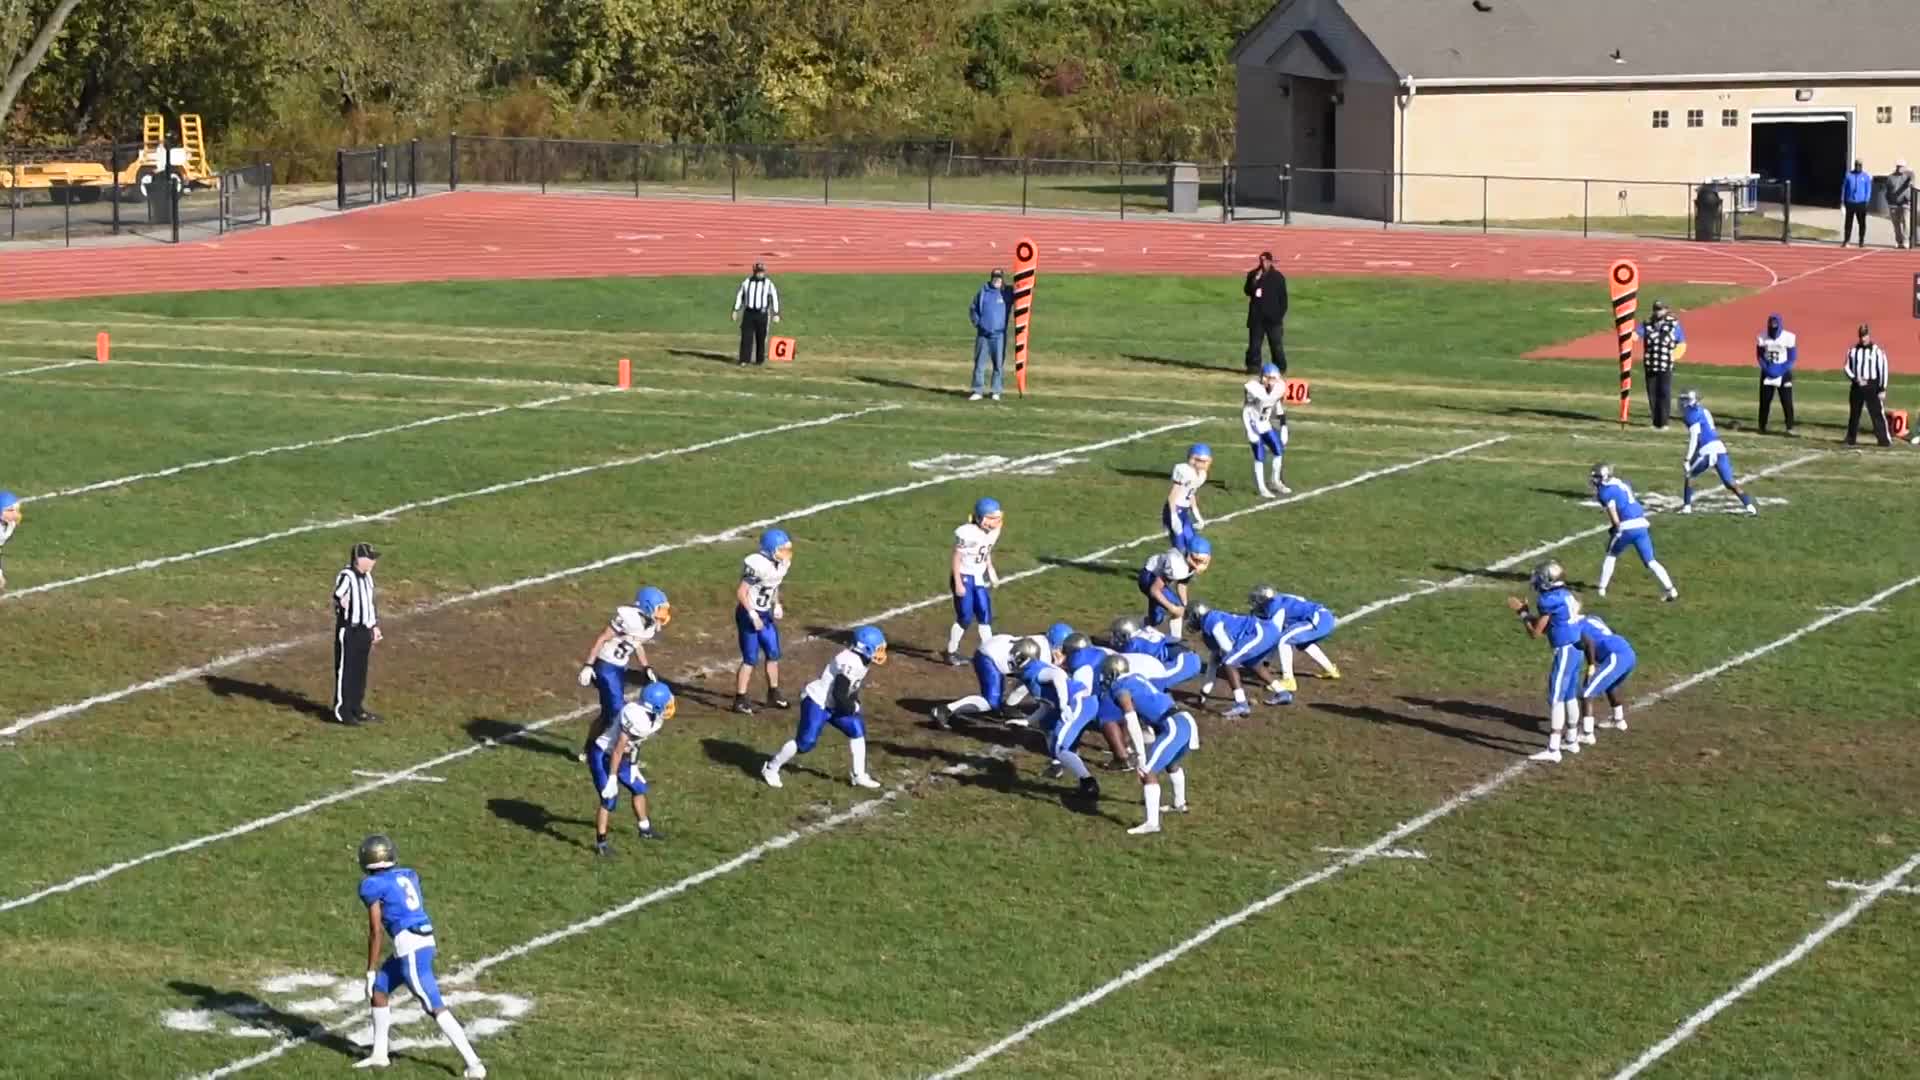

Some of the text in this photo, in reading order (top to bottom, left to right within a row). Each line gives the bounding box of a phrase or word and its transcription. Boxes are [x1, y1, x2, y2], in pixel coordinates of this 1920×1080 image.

[775, 341, 787, 357] G
[1286, 383, 1305, 401] 10
[396, 876, 420, 911] 3
